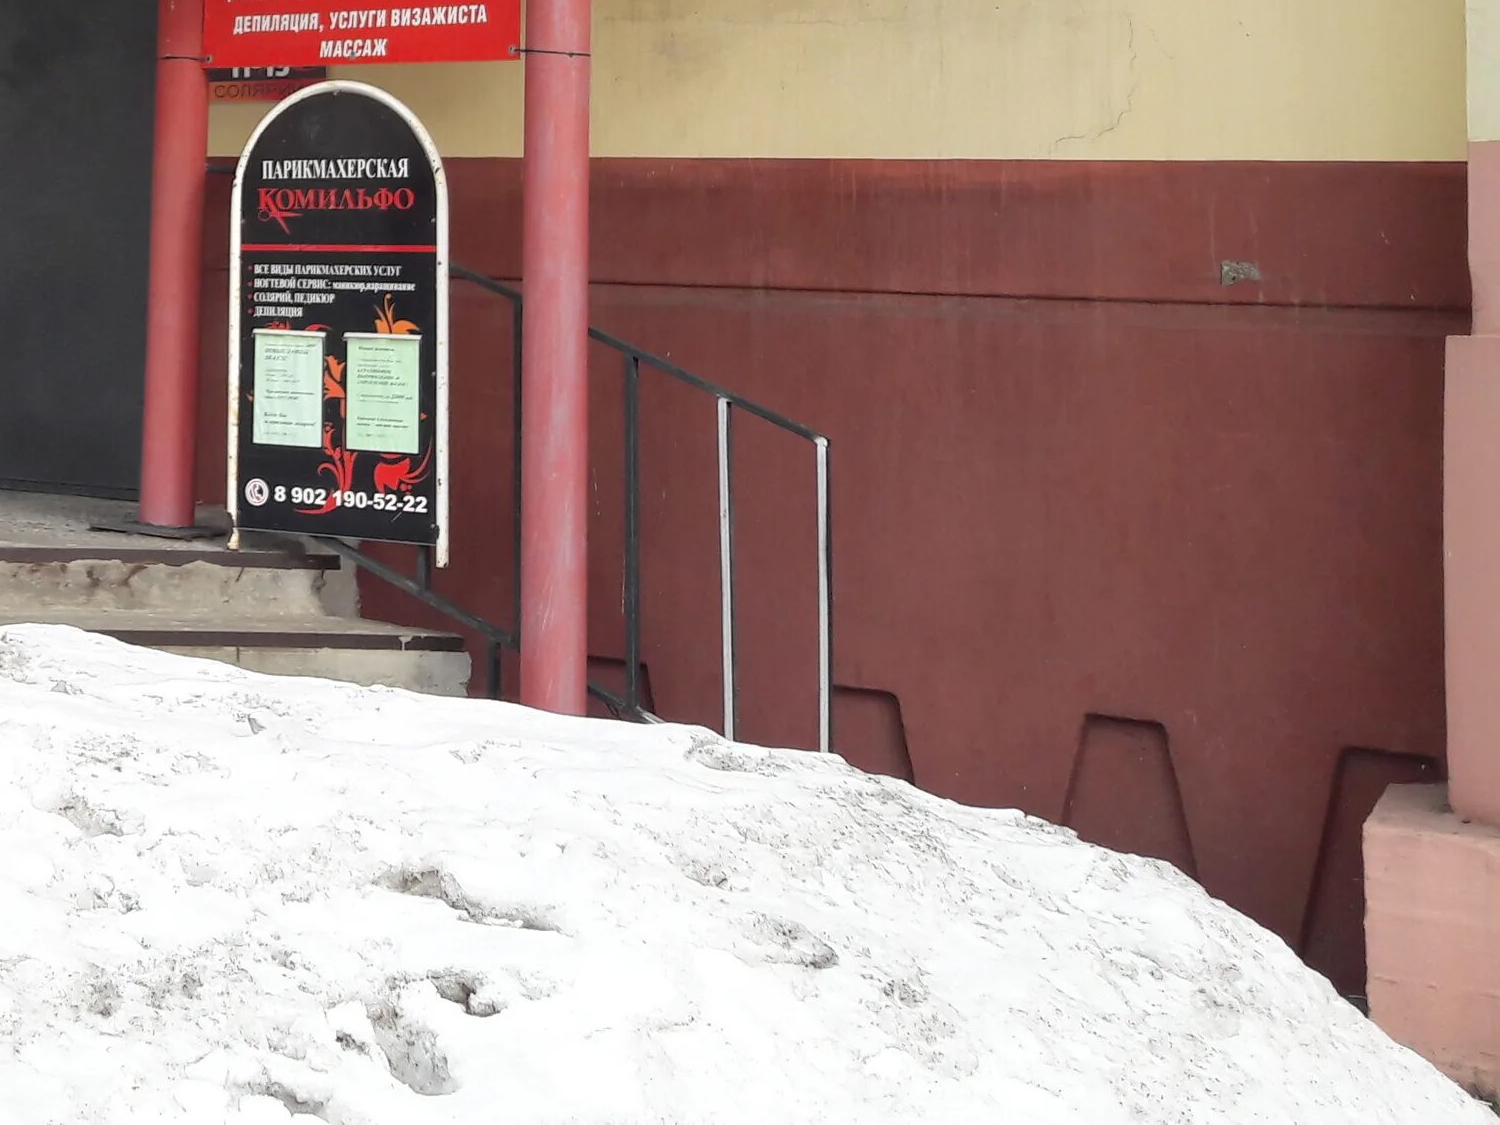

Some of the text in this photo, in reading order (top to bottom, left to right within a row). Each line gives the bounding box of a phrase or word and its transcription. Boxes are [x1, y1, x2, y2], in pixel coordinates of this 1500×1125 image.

[233, 4, 488, 35] ДЕПИЛЯЦИЯ, УСЛУГИ ВИЗАЖИСТА
[319, 38, 388, 58] МАССАЖ
[262, 158, 409, 180] ПАРИКМАХЕРСКАЯ
[257, 187, 415, 211] КОМИЛЬФО
[254, 264, 402, 276] ВСЕ ВИДЫ ПАРИКМАХЕРСКИХ УСЛУГ
[253, 277, 296, 289] НОГТЕВОЙ
[294, 293, 335, 304] ПЕДИКЮР
[253, 306, 303, 317] ДЕПИЛЯЦИЯ
[274, 485, 428, 513] 8 902 190-52-22
